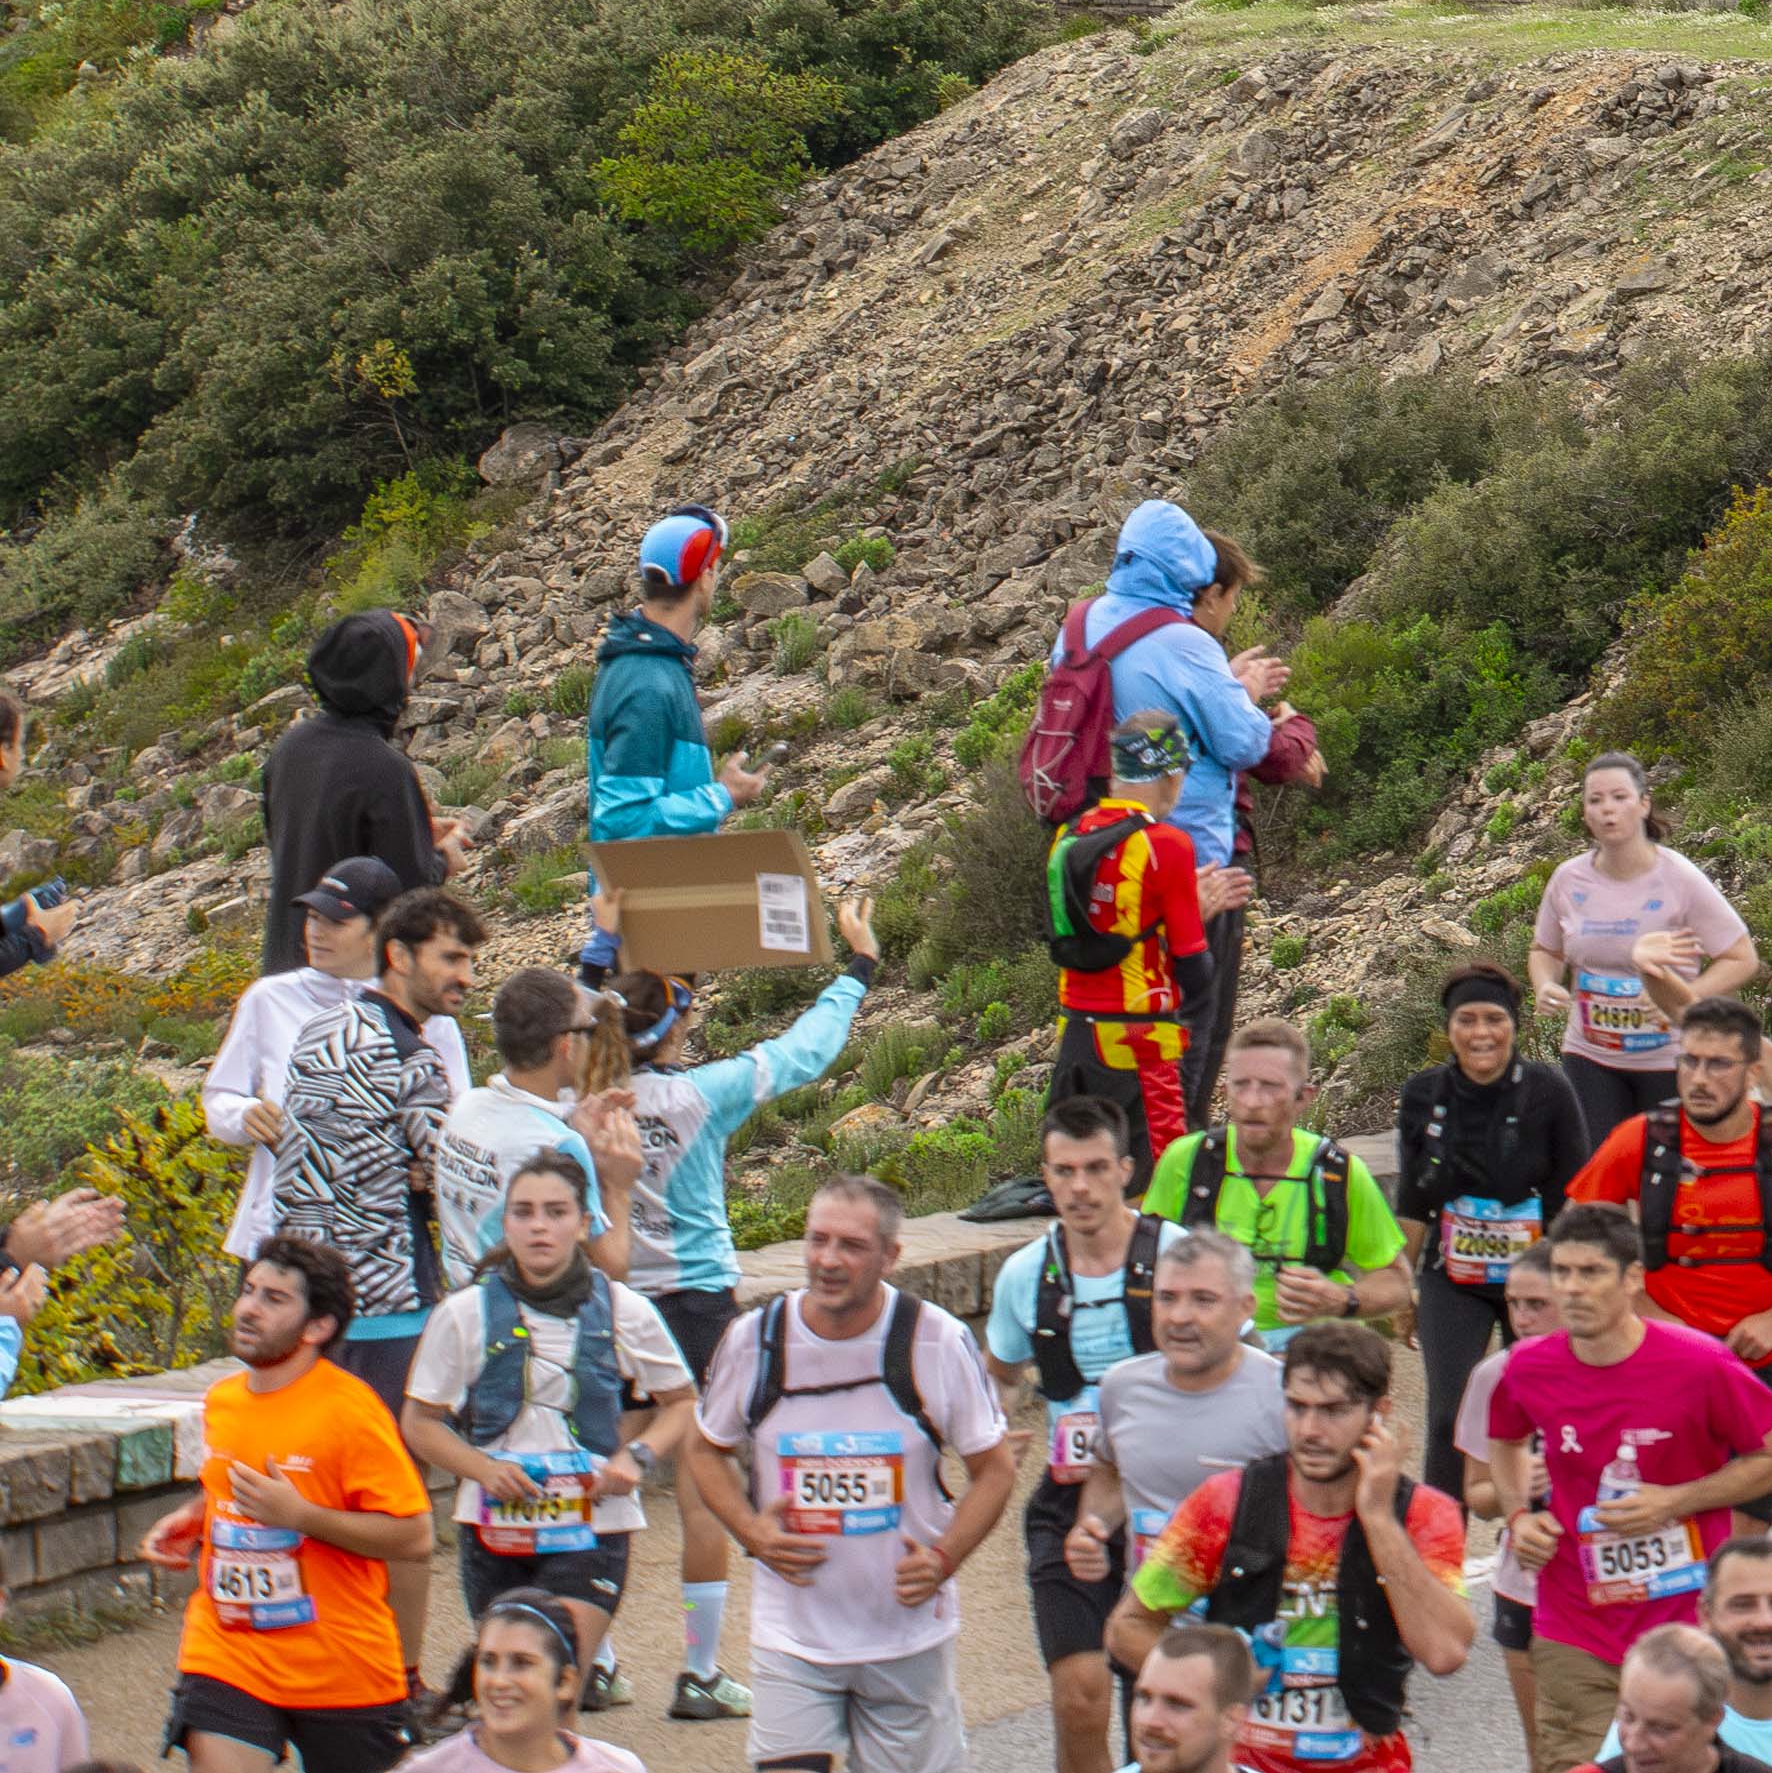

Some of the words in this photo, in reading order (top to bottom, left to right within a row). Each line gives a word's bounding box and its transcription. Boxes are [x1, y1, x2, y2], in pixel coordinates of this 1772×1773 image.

[801, 1472, 868, 1505] 5055
[1601, 1536, 1669, 1575] 5053
[216, 1565, 273, 1601] 4613
[1256, 1685, 1325, 1725] 6131
